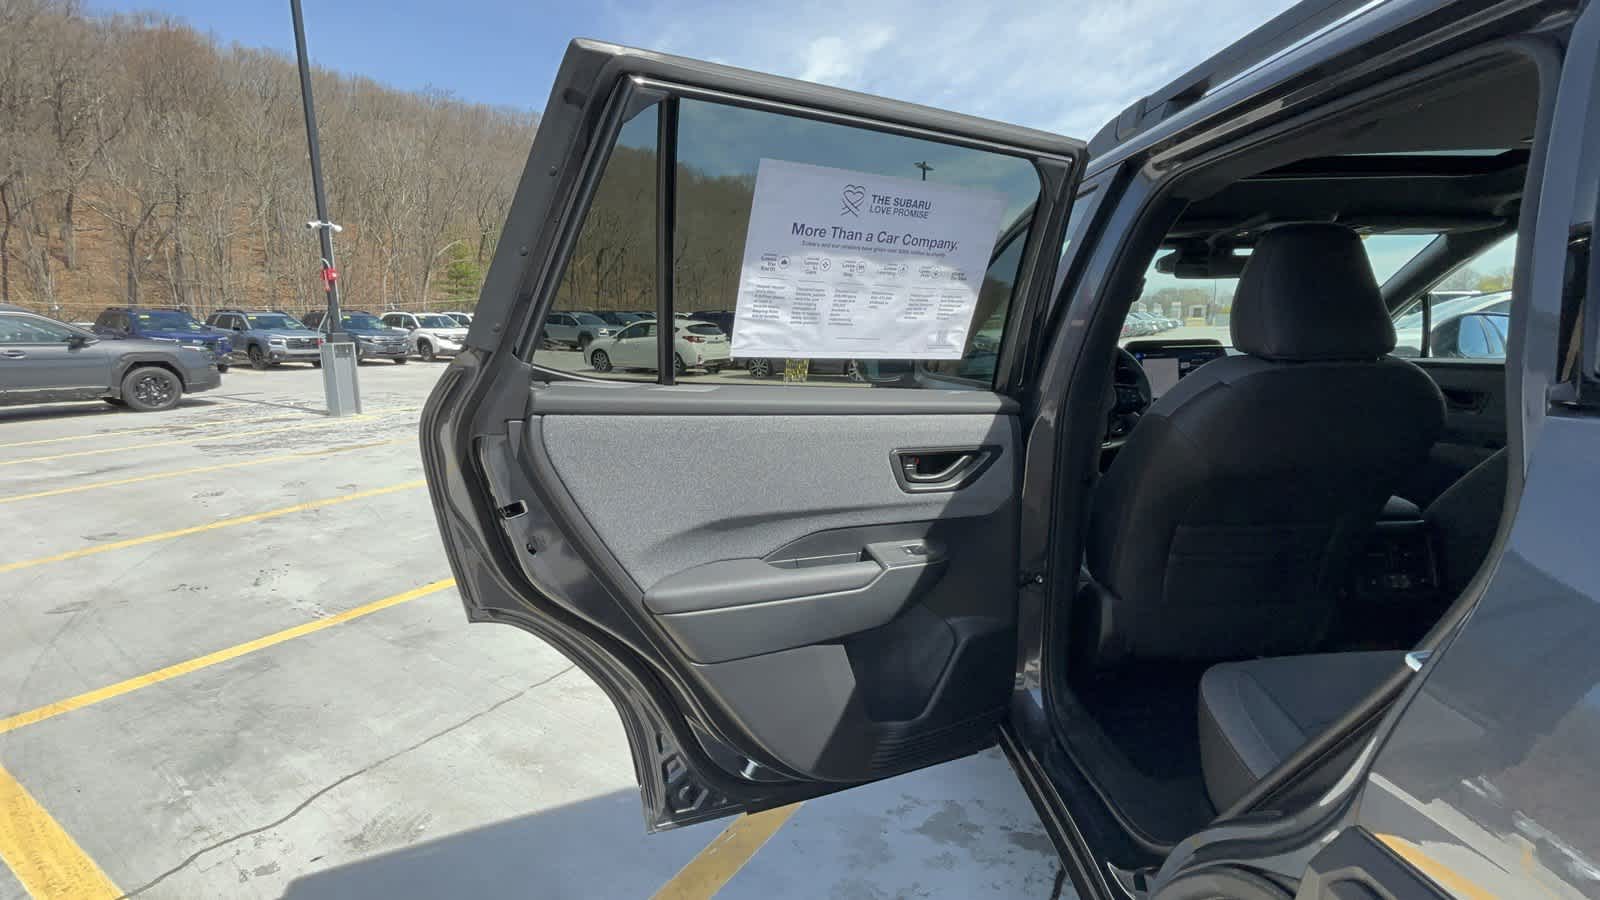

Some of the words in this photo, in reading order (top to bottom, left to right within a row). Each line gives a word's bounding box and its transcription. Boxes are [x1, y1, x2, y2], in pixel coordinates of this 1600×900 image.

[871, 194, 891, 205] THE
[893, 197, 931, 210] SUBARU
[870, 204, 891, 215] LOVE
[893, 207, 929, 219] PROMISE
[791, 222, 826, 238] More
[832, 226, 863, 241] Than
[865, 232, 874, 242] a
[877, 231, 900, 245] Car
[902, 233, 958, 252] Company.
